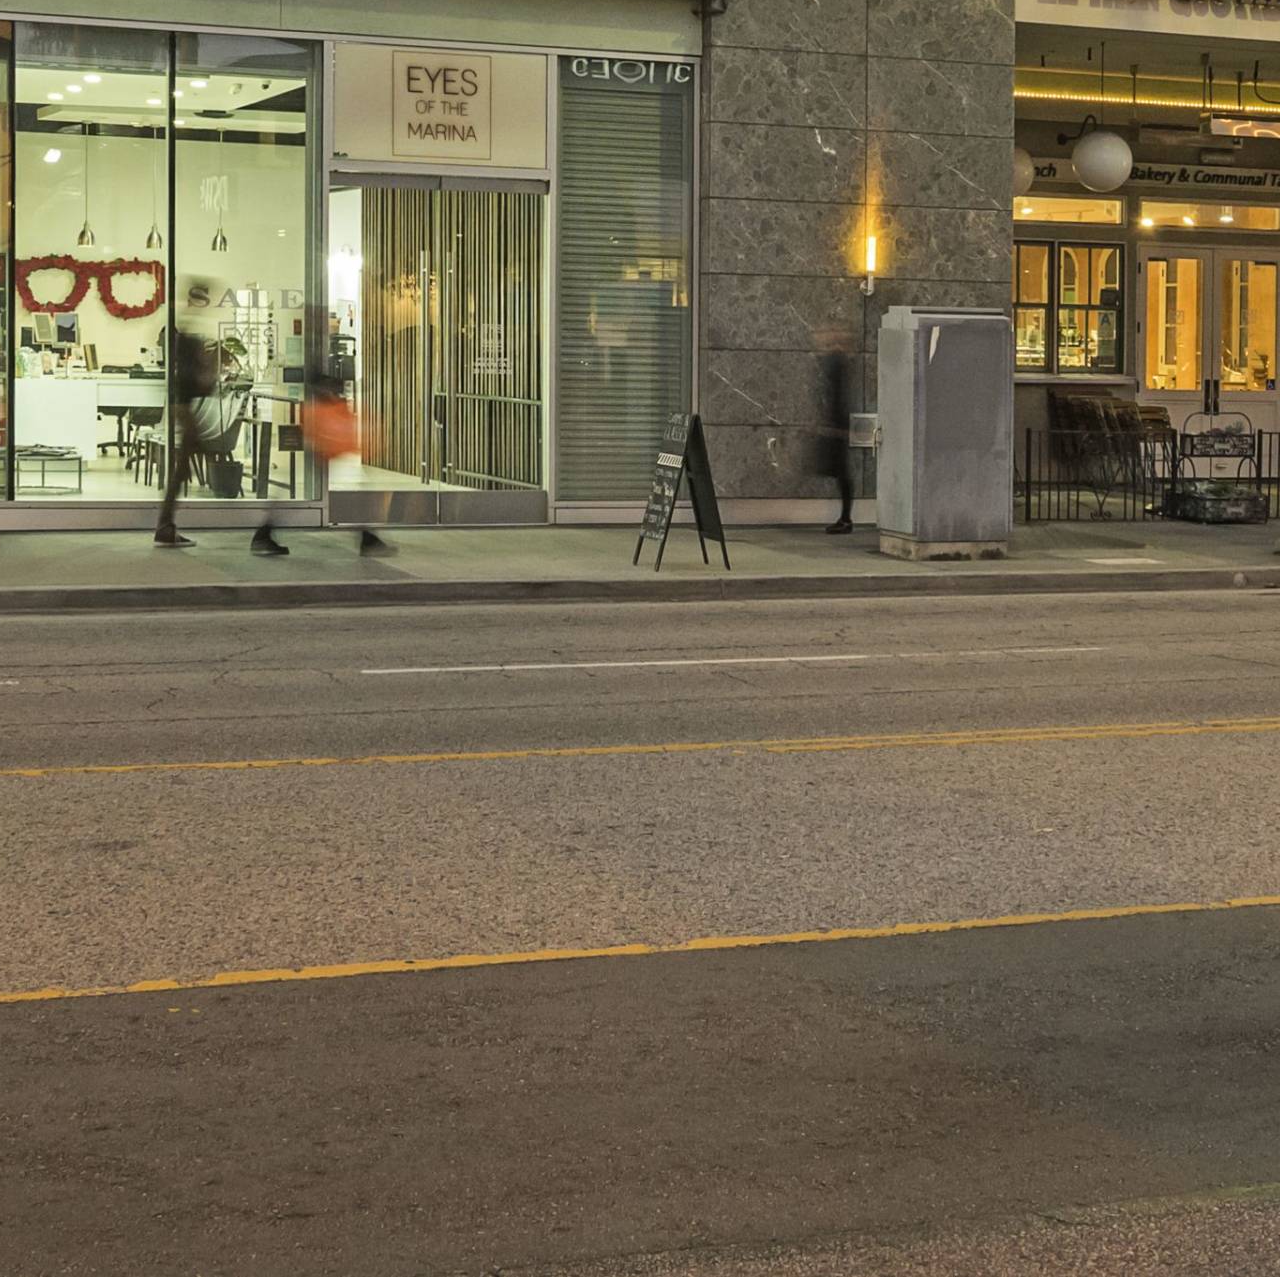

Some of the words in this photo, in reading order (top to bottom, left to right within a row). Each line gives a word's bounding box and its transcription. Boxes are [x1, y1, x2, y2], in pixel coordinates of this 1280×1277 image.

[406, 65, 479, 97] EYES
[415, 99, 435, 115] OF
[441, 100, 469, 117] THE
[407, 122, 478, 142] MARINA
[1130, 166, 1176, 184] Bakery
[1178, 167, 1190, 182] &
[1194, 170, 1267, 186] Communal
[187, 286, 305, 310] SALE
